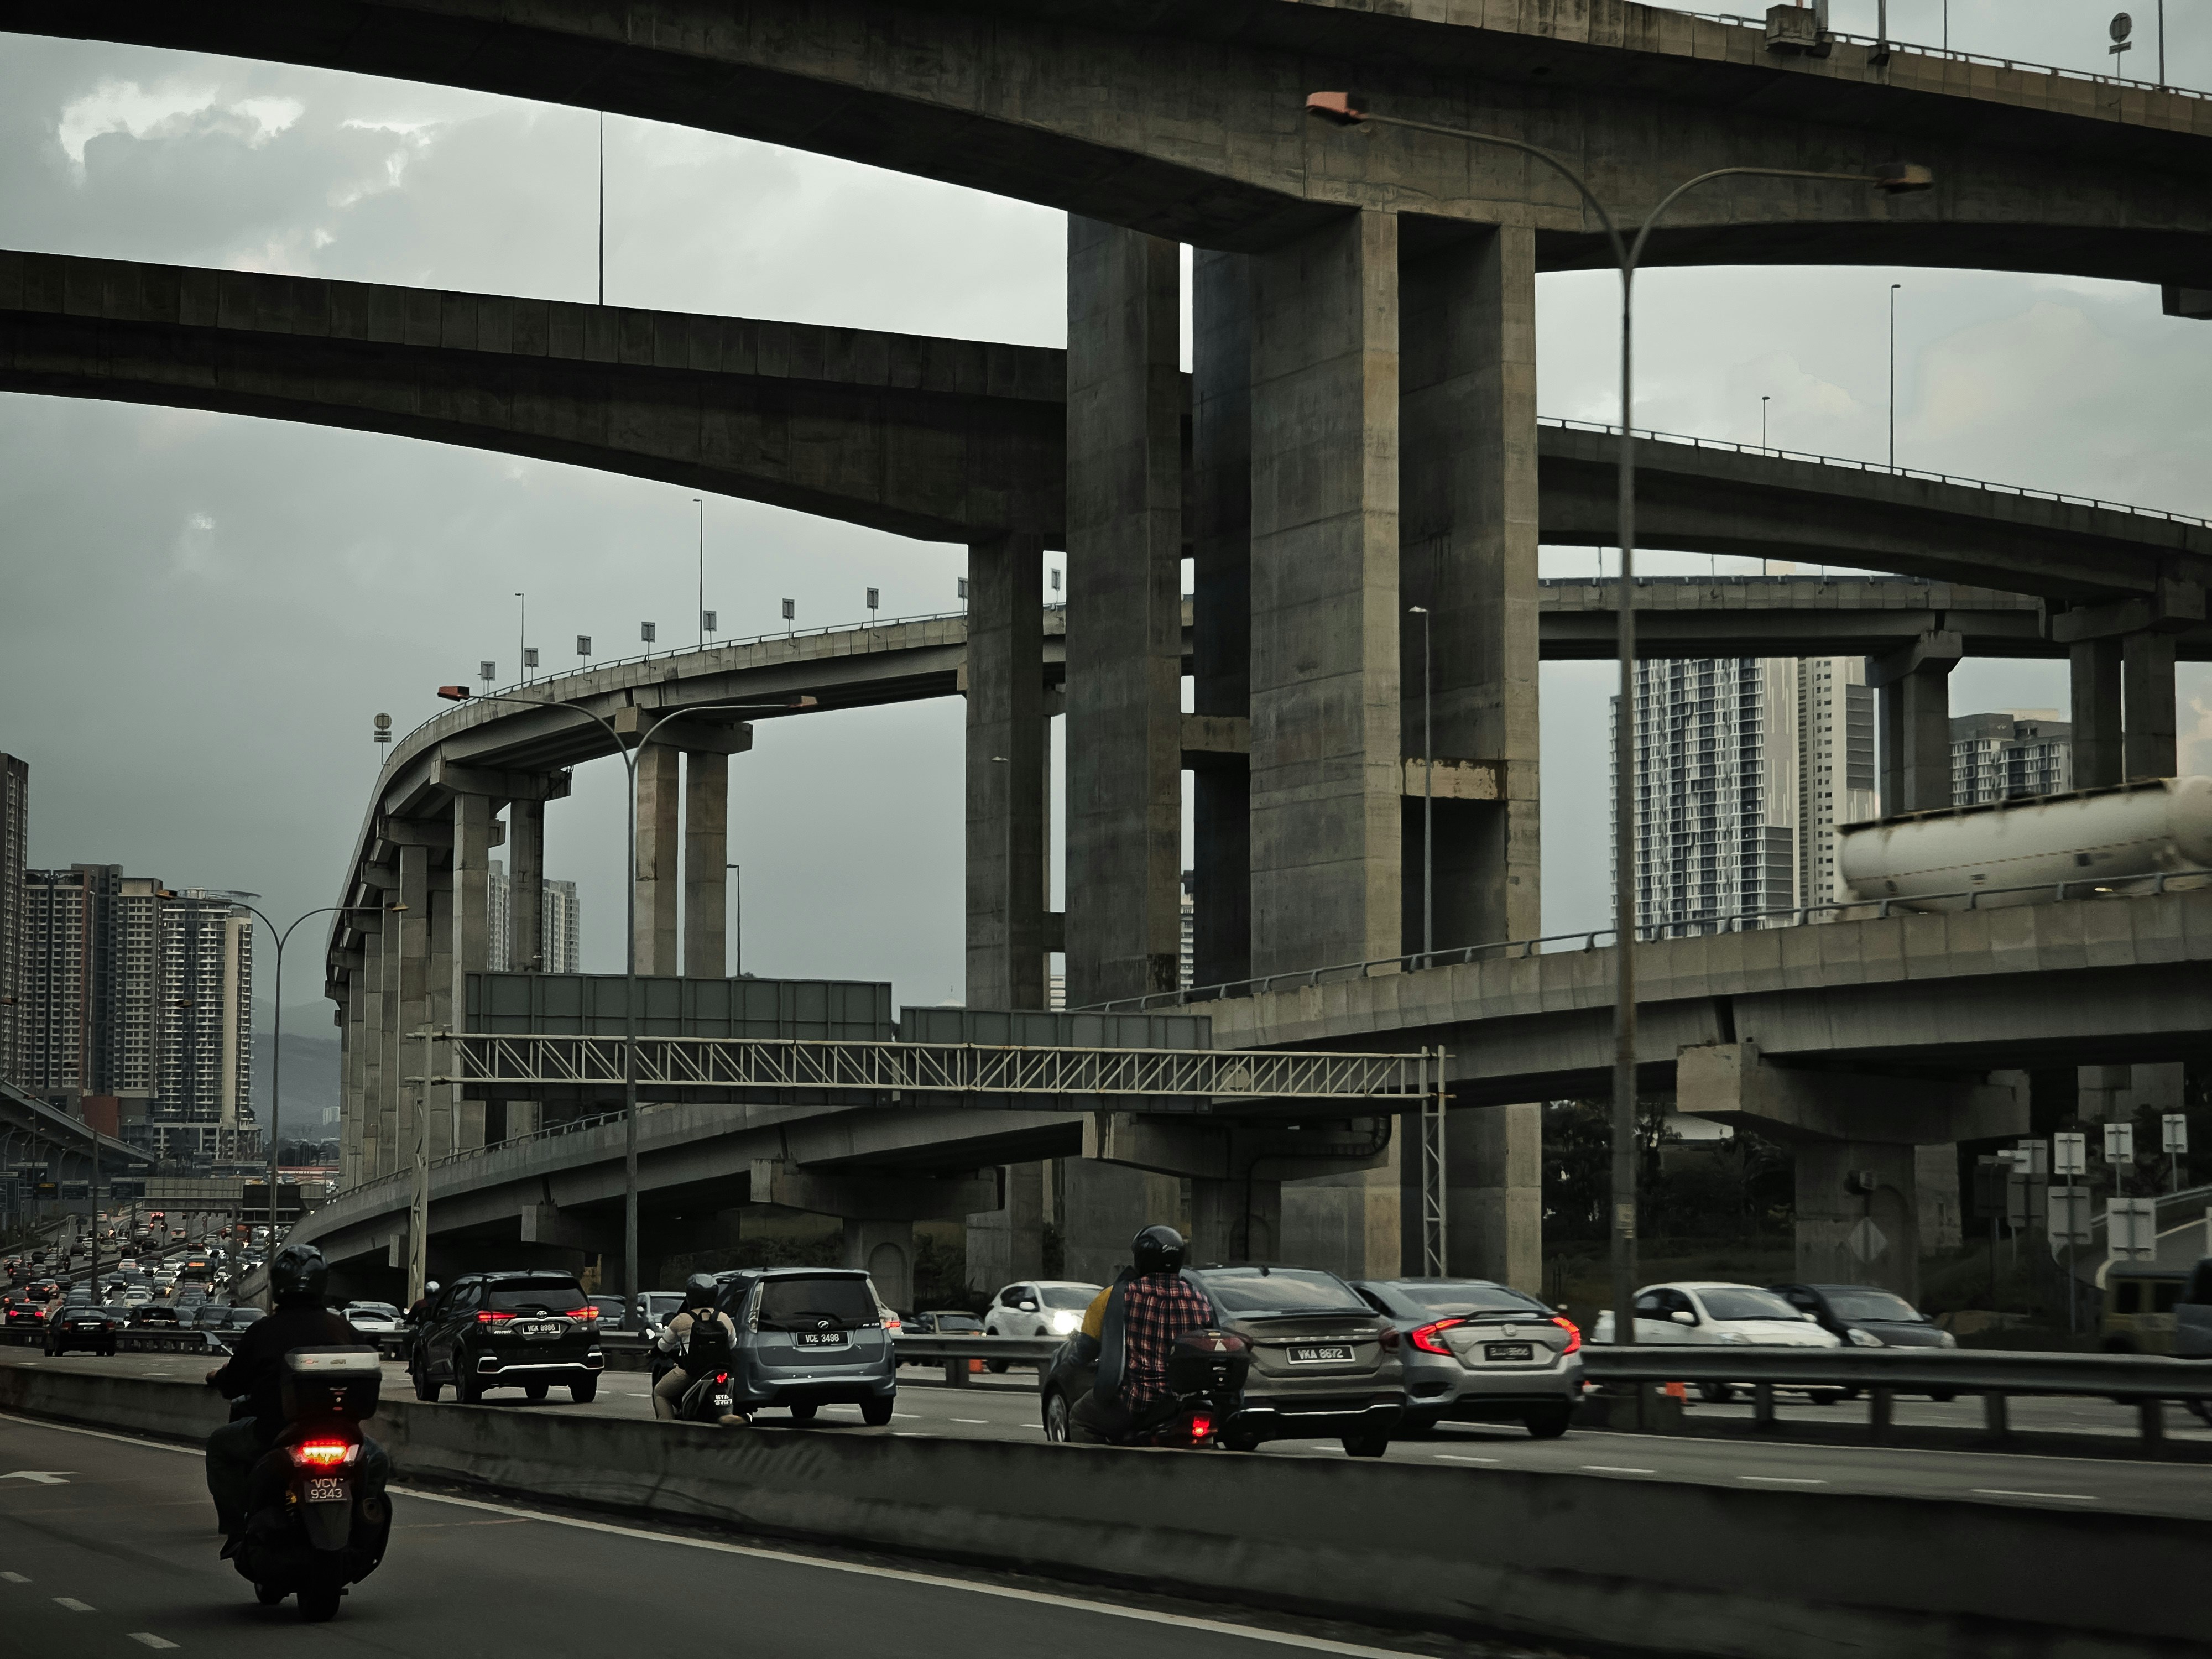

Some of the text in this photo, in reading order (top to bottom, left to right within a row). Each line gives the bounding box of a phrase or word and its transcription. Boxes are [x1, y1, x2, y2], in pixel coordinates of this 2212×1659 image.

[805, 1333, 839, 1343] VCE 3498
[1297, 1348, 1344, 1359] VKA 8672
[311, 1489, 342, 1499] 9343
